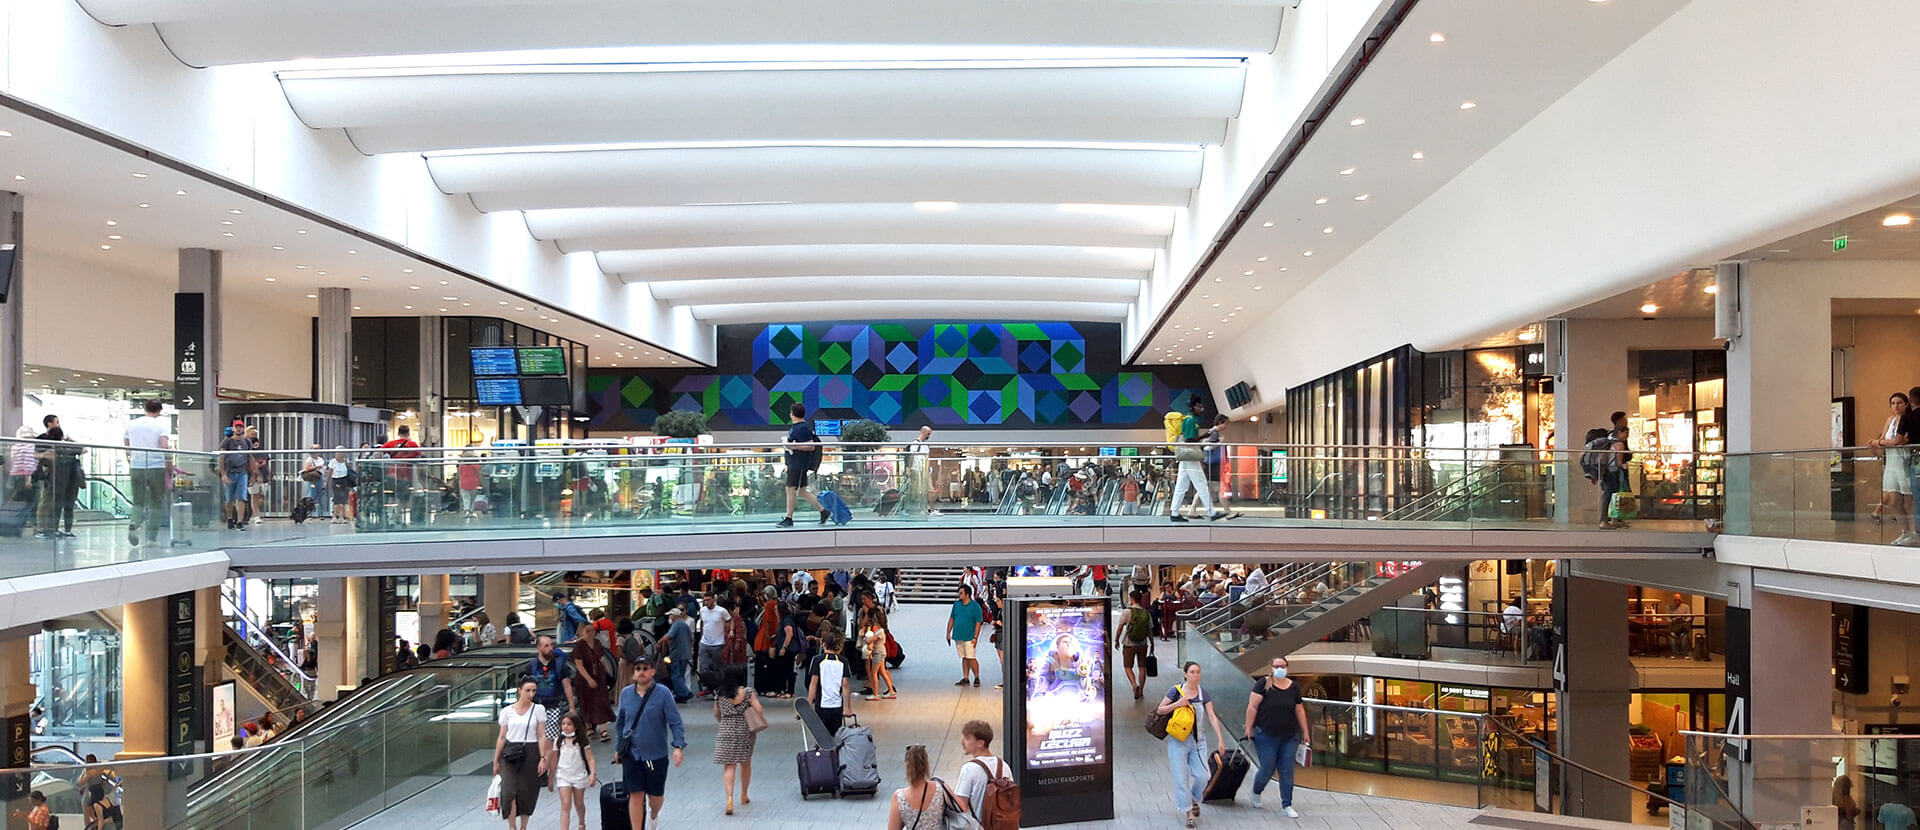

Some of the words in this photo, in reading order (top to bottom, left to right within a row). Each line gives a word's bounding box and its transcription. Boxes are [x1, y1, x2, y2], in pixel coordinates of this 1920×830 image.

[1554, 643, 1566, 691] 4
[1727, 672, 1740, 686] Hall
[178, 692, 191, 704] BUS
[15, 726, 23, 740] P
[179, 722, 189, 742] P
[1727, 696, 1748, 762] 4
